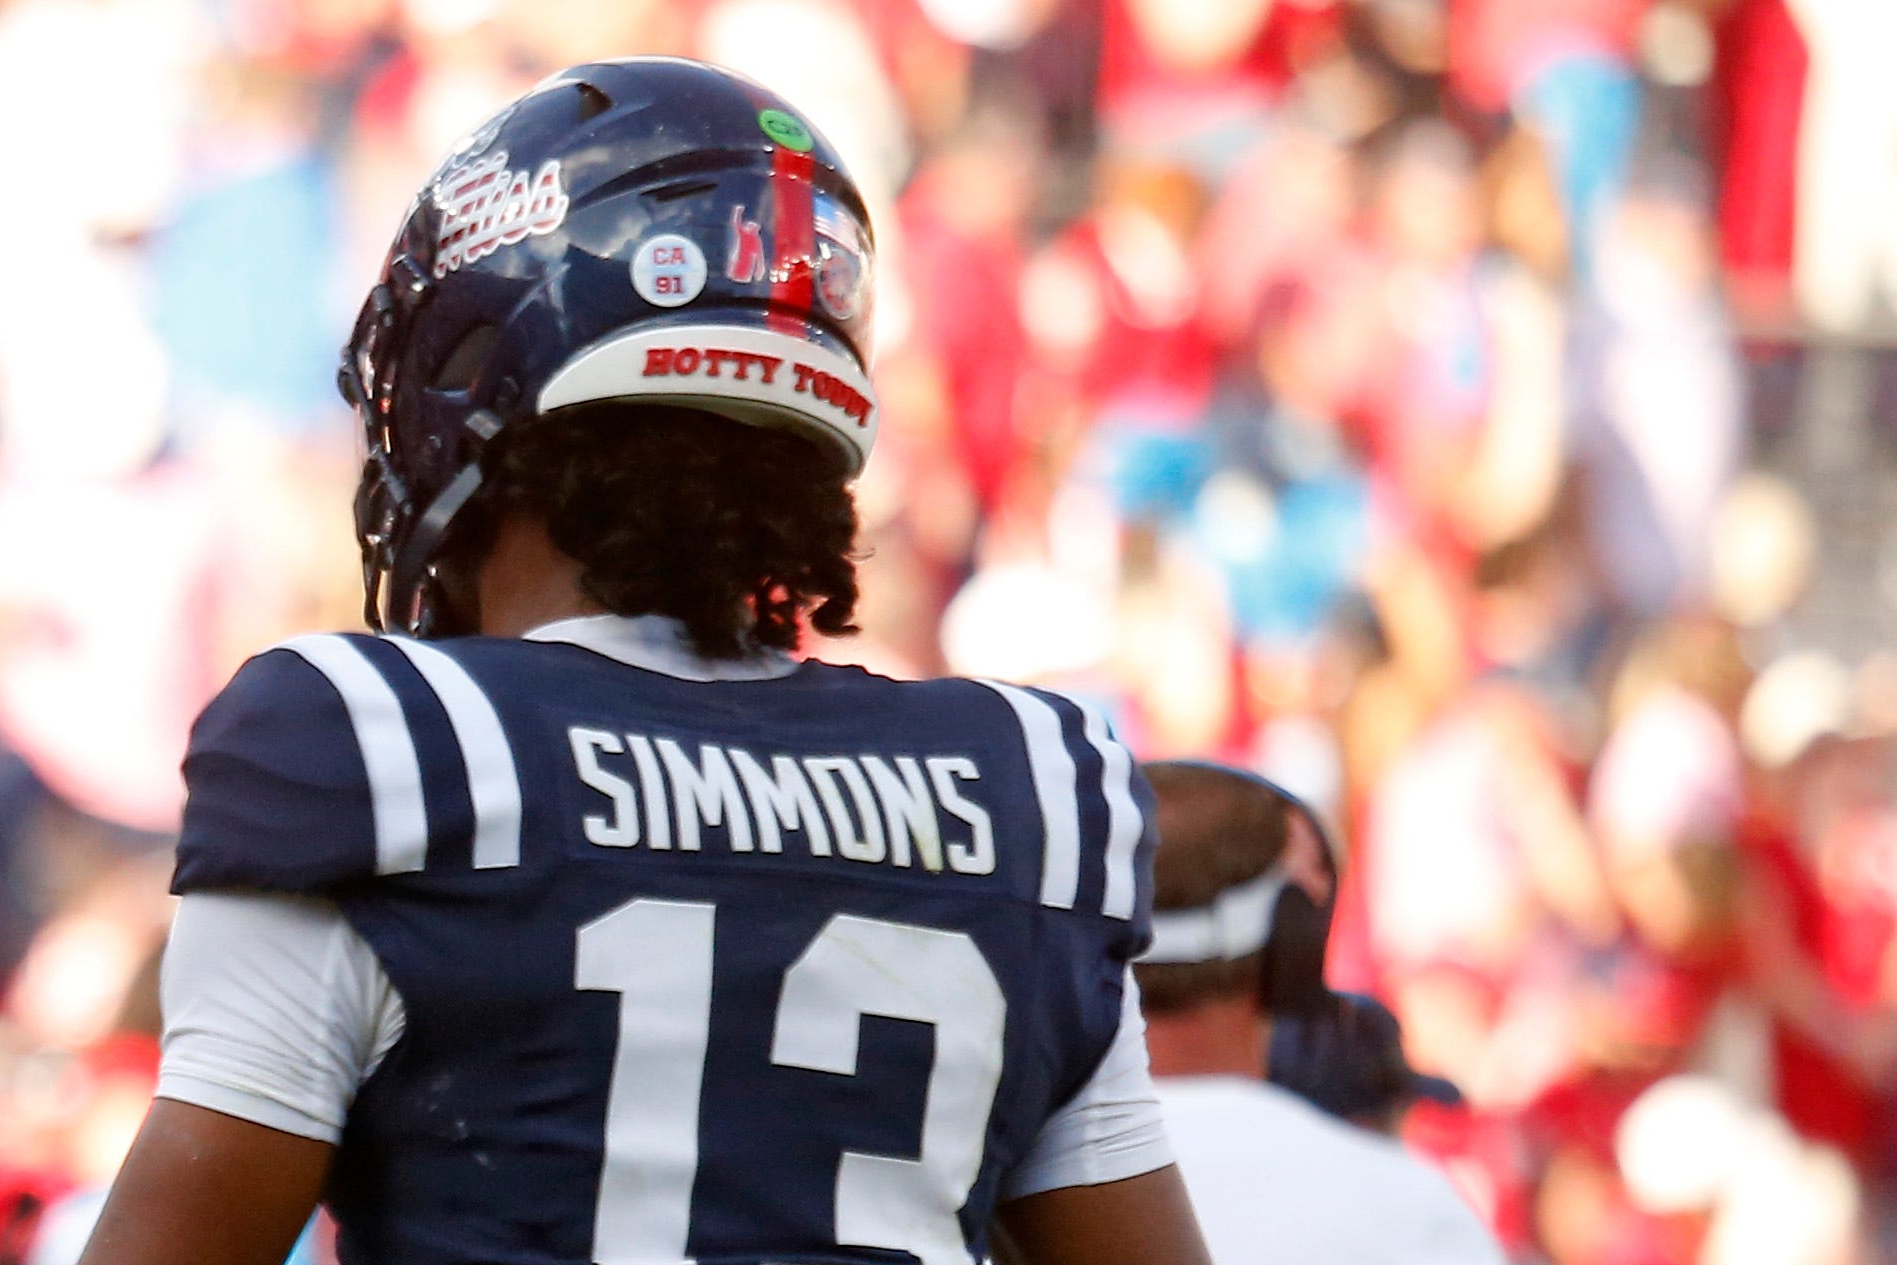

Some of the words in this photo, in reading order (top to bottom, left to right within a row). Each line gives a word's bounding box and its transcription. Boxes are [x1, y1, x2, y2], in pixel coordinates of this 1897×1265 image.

[652, 247, 686, 266] CA
[655, 276, 684, 295] 91
[643, 347, 784, 384] HOTTY
[567, 726, 995, 875] SIMMONS
